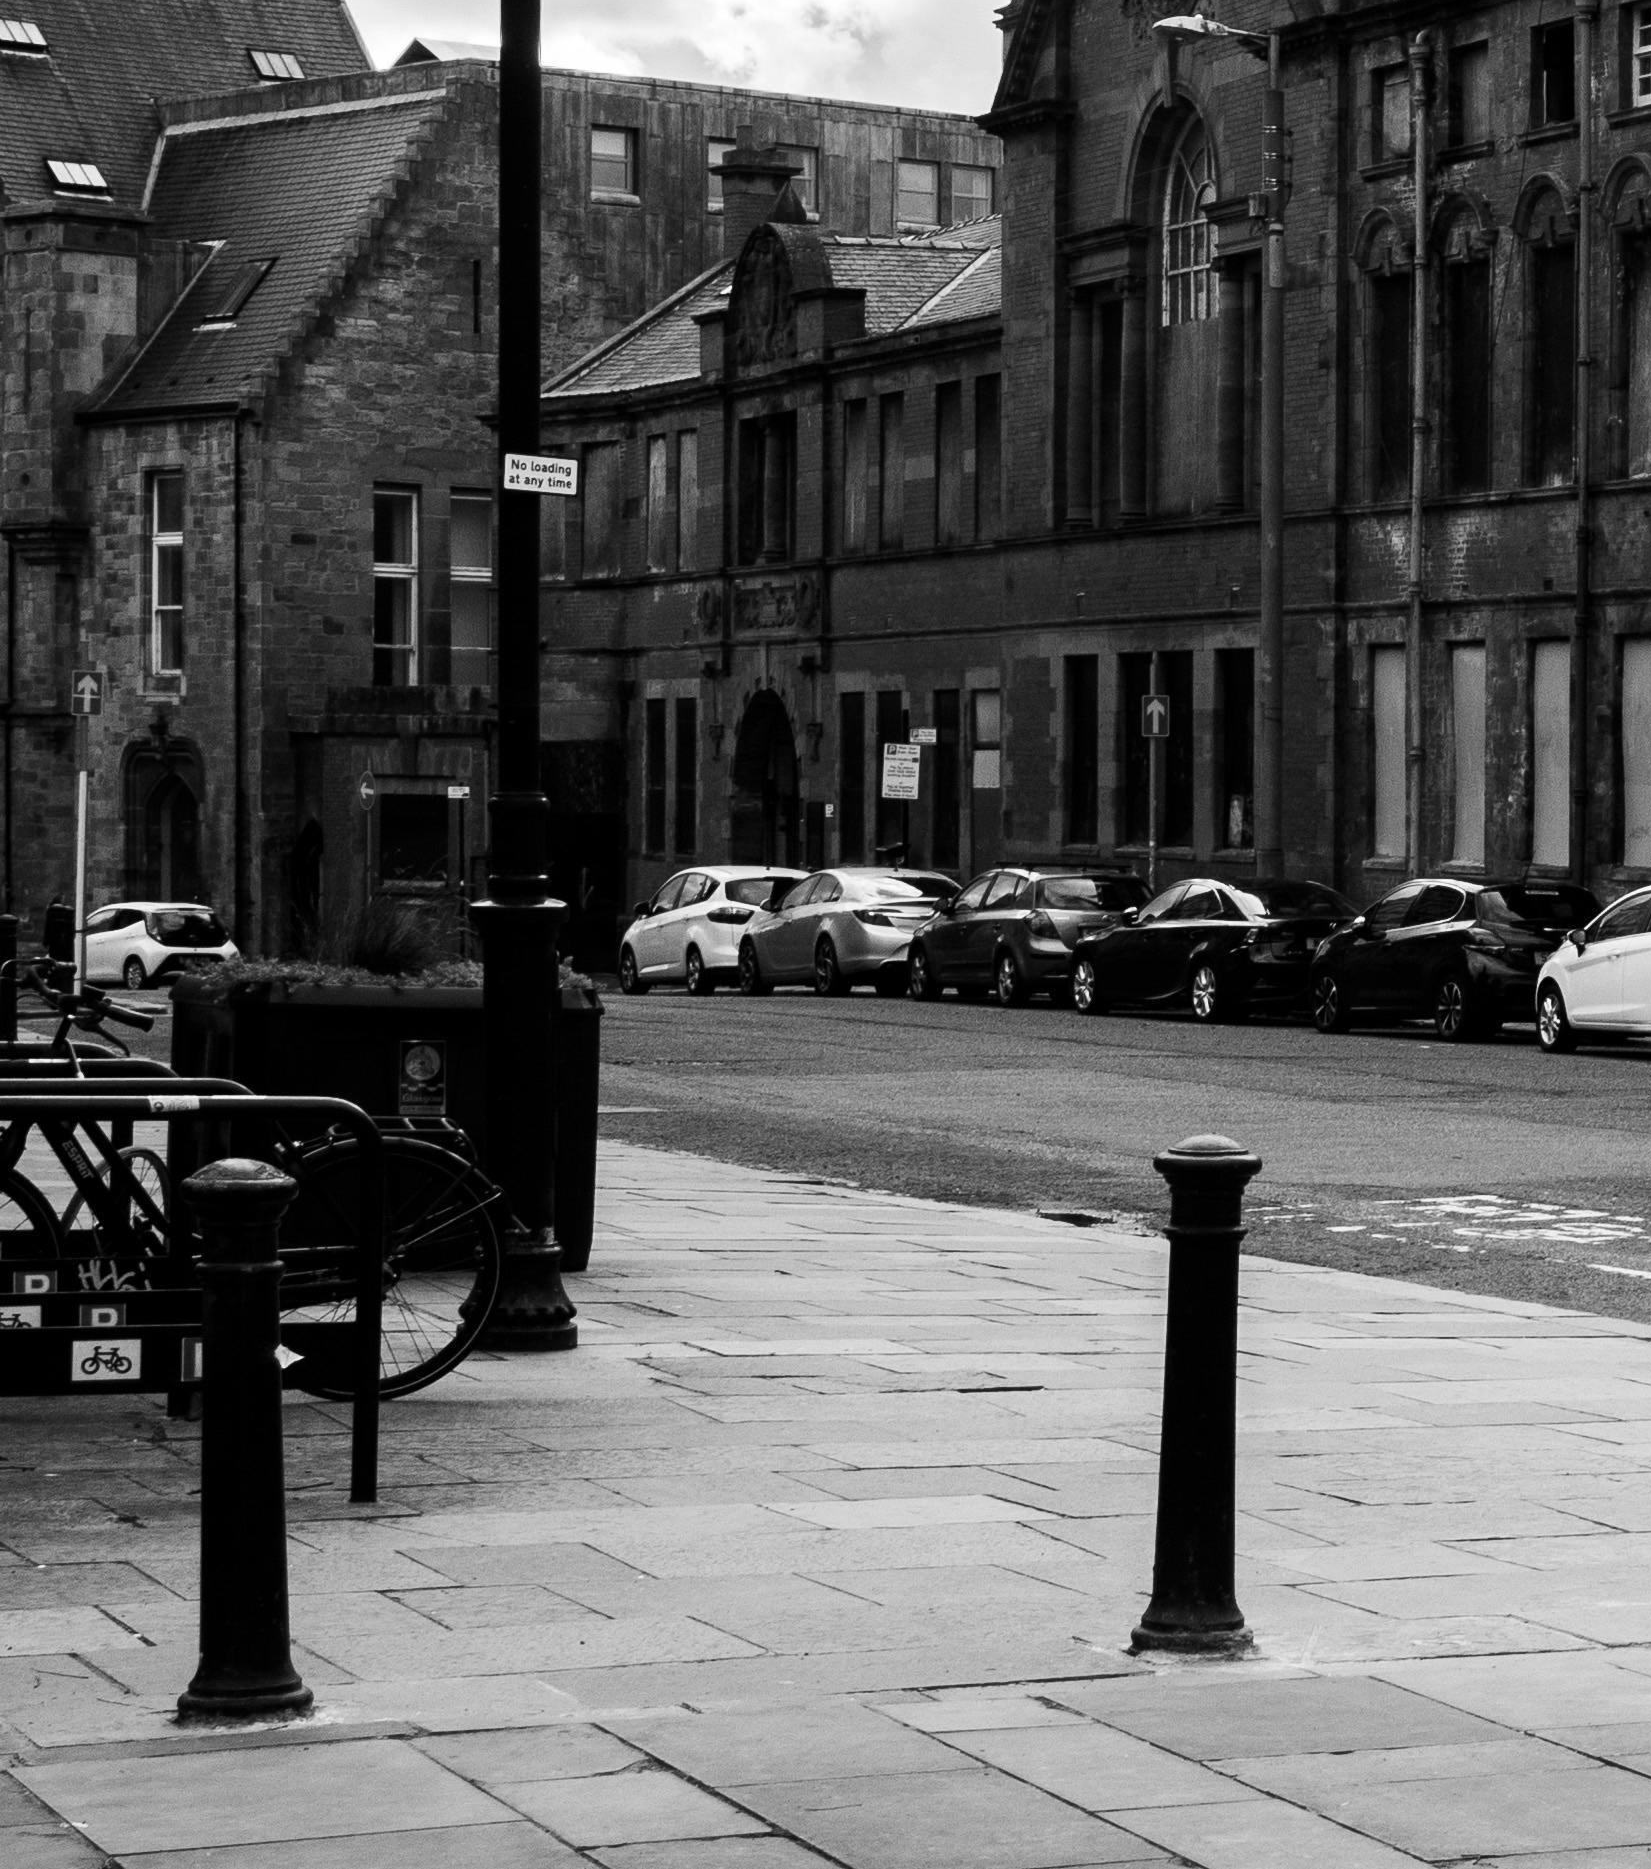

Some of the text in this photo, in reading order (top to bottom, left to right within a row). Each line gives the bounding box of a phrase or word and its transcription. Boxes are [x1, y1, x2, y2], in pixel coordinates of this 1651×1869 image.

[511, 459, 572, 477] No loading
[509, 473, 572, 489] at any time
[61, 1140, 95, 1179] ESPRIT
